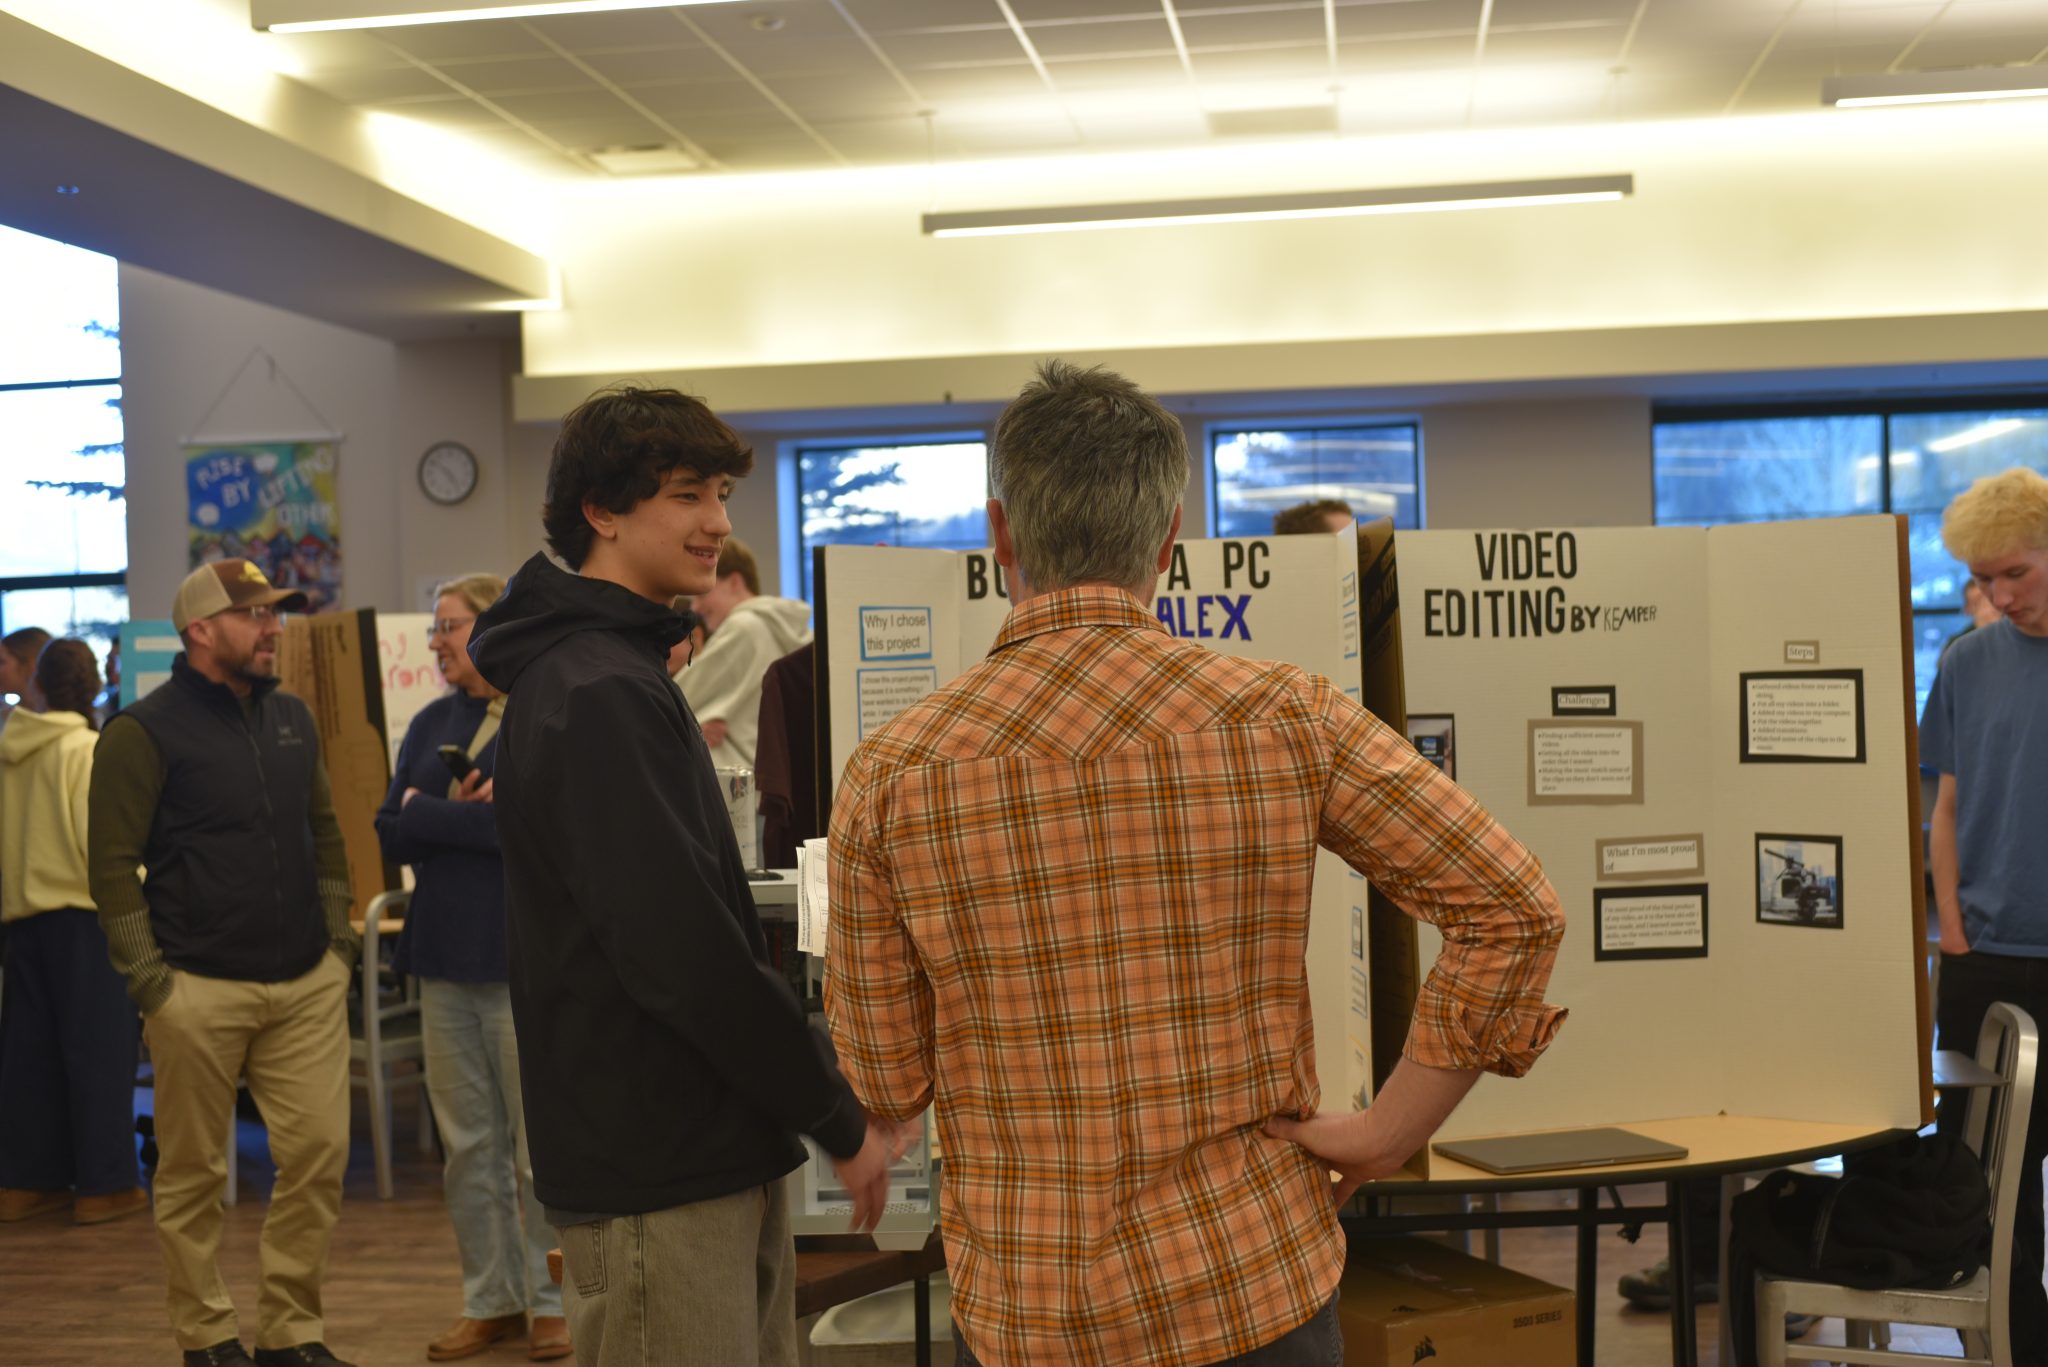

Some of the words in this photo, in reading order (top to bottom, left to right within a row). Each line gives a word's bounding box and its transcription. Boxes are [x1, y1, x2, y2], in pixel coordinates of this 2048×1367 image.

[221, 478, 251, 508] BY
[1474, 531, 1577, 581] VIDEO
[1167, 543, 1191, 591] A
[1223, 541, 1270, 589] PC
[1156, 594, 1252, 641] ALEX
[1424, 586, 1566, 638] EDITING
[1570, 605, 1601, 633] BY
[1603, 605, 1657, 632] KEMPER
[864, 614, 888, 631] Why
[890, 614, 894, 627] I
[896, 613, 927, 627] chose
[866, 637, 884, 651] this
[886, 636, 921, 653] project
[1789, 647, 1814, 658] Steps
[1558, 695, 1607, 708] Challenges
[1606, 847, 1630, 857] What
[1632, 846, 1646, 856] I'm
[1648, 846, 1669, 855] most
[1670, 843, 1696, 855] proud
[1605, 862, 1614, 872] of
[1535, 1310, 1562, 1325] SERIES
